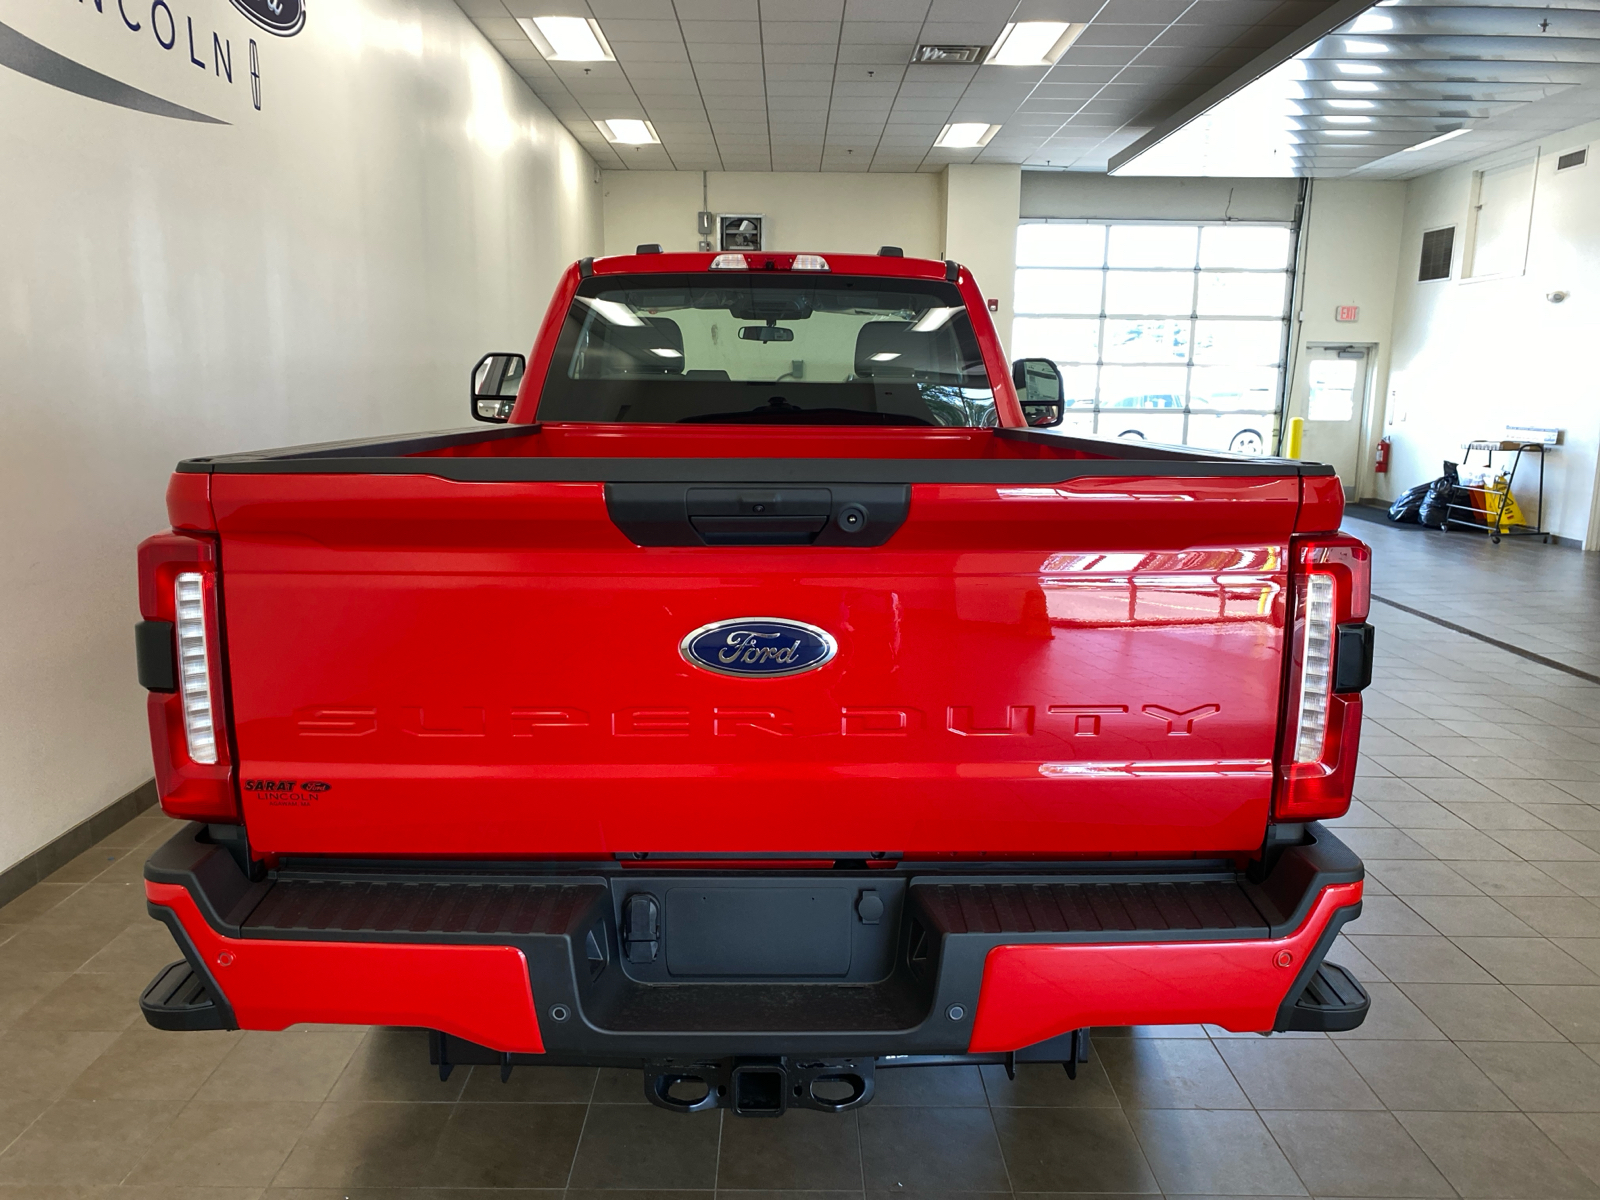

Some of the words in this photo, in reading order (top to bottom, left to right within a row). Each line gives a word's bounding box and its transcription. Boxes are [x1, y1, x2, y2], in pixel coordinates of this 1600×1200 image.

[79, 0, 232, 84] COLN
[1340, 306, 1357, 320] EXIT
[718, 630, 801, 664] Ford
[294, 704, 795, 737] SUPER
[841, 704, 1221, 737] DUTY
[245, 780, 296, 792] SARAT
[305, 782, 327, 791] Ford
[257, 793, 319, 801] LINCOLN
